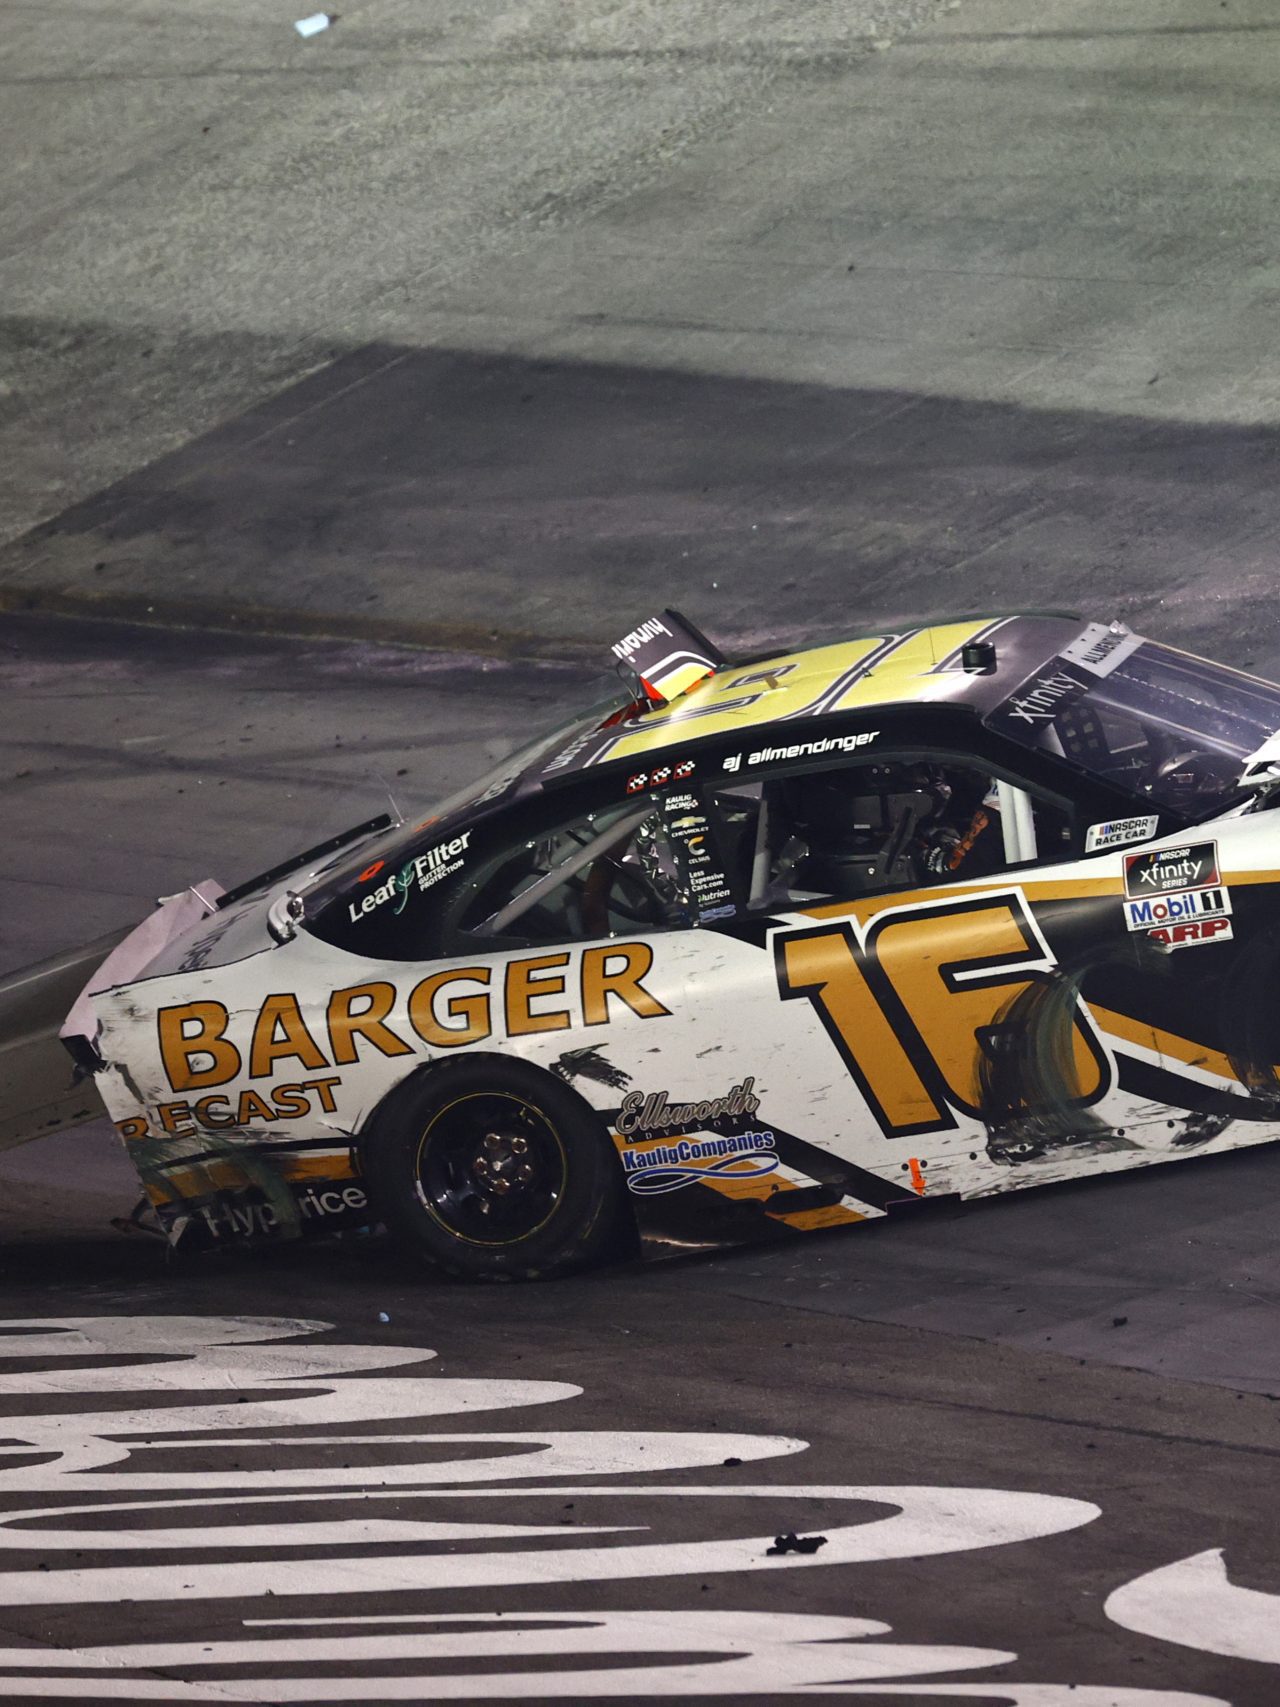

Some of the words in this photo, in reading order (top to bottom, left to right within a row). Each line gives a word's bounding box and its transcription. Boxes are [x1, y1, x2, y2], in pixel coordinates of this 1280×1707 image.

[1008, 671, 1089, 725] xfinity
[722, 752, 742, 773] aj
[747, 730, 881, 766] allmendinger
[671, 826, 709, 838] CHEVROLET
[1095, 833, 1122, 847] RACE
[1124, 828, 1146, 840] CAR
[1106, 818, 1149, 835] NASCAR
[1159, 848, 1191, 861] NASCAR
[348, 874, 397, 923] Leaf
[414, 830, 471, 879] Filter
[418, 863, 447, 884] GUTTER
[419, 858, 465, 892] PROTECTION
[688, 869, 705, 879] Less
[690, 872, 725, 886] Expensive
[1140, 858, 1203, 887] xfinity
[1161, 877, 1188, 890] SERIES
[1130, 893, 1197, 924] Mobil
[1149, 918, 1229, 945] ARP
[156, 942, 673, 1093] BARGER
[773, 886, 1119, 1140] 16
[113, 1076, 342, 1140] RECAST
[615, 1076, 760, 1135] Ellsworth
[627, 1114, 756, 1143] ADVISORS
[622, 1131, 776, 1172] KauligCompanies
[200, 1186, 368, 1237] Hyprice
